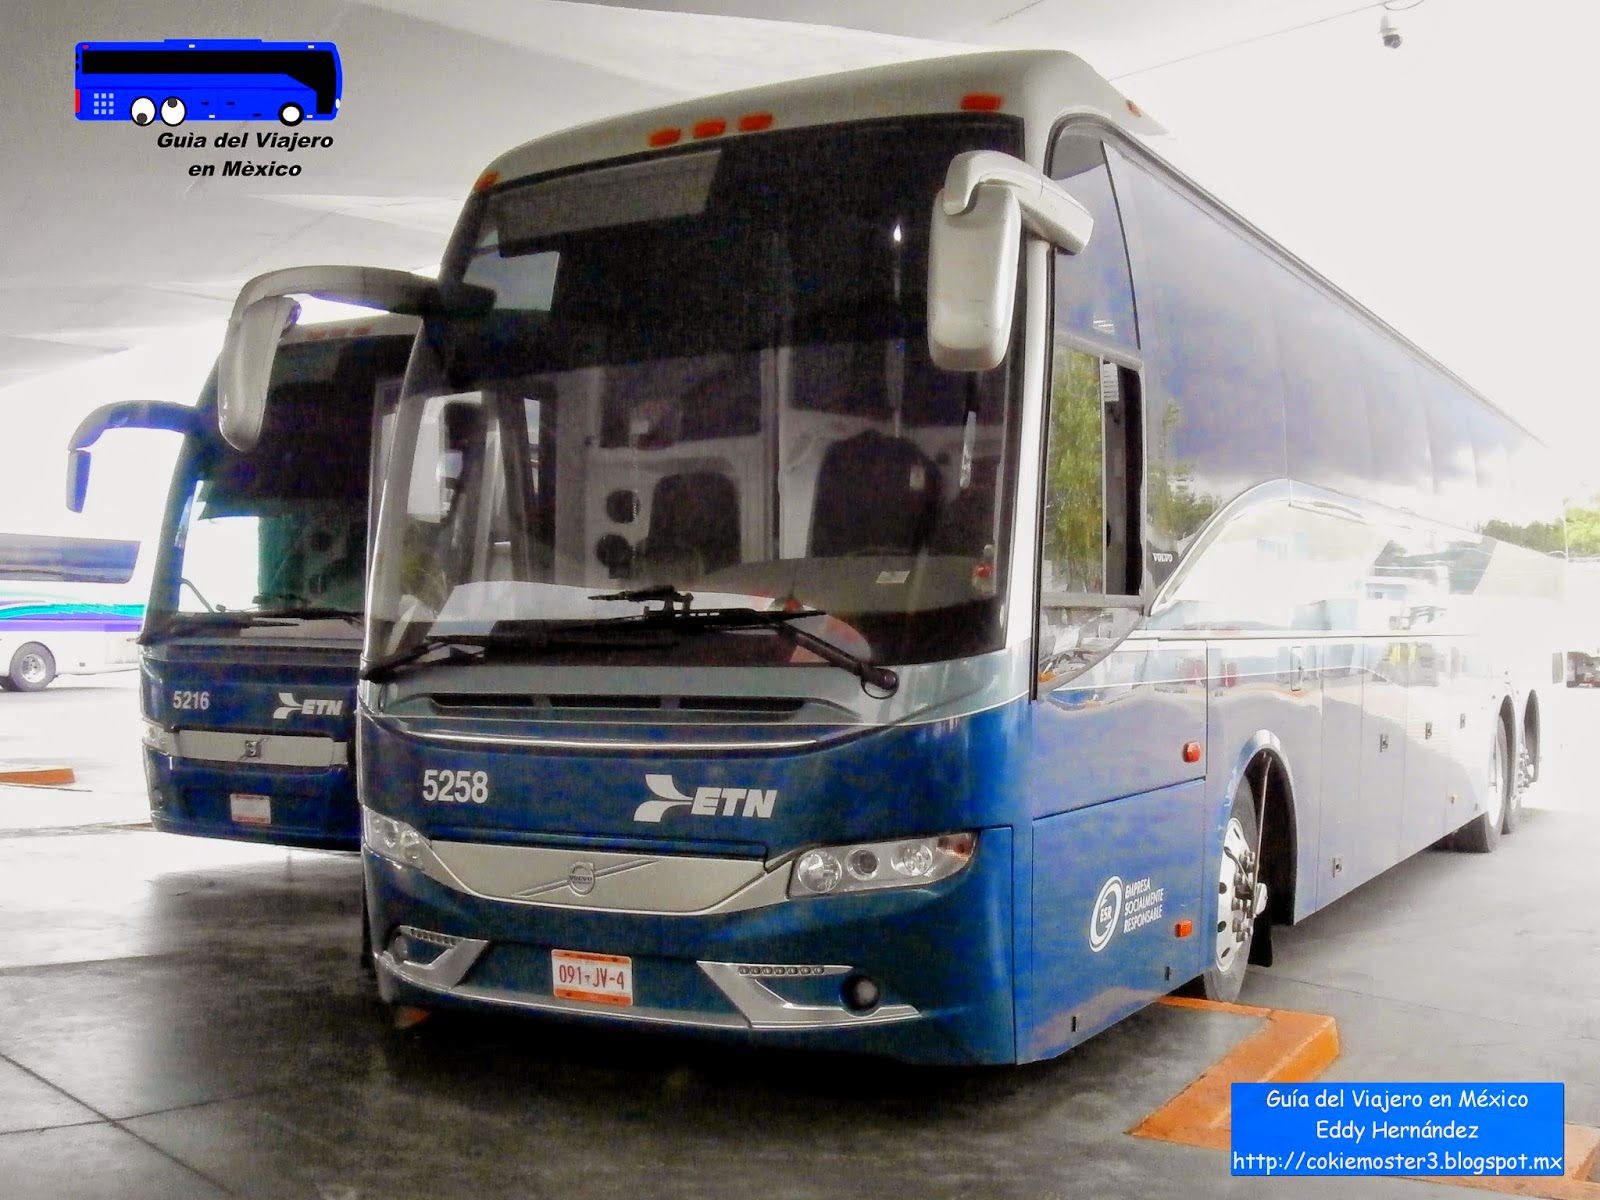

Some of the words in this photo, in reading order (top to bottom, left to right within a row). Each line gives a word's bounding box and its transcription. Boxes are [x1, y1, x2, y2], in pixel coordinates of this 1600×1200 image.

[1152, 552, 1173, 563] VOLVO
[172, 690, 211, 711] 5216
[301, 699, 344, 716] ETN
[422, 769, 489, 804] 5258
[690, 786, 778, 819] ETN
[1124, 877, 1151, 899] EMPRESA
[1099, 905, 1113, 923] ESR
[1124, 888, 1165, 917] SOCIALMENTE
[1123, 904, 1163, 934] RESPONSABLE
[558, 964, 625, 990] 091-JV-4
